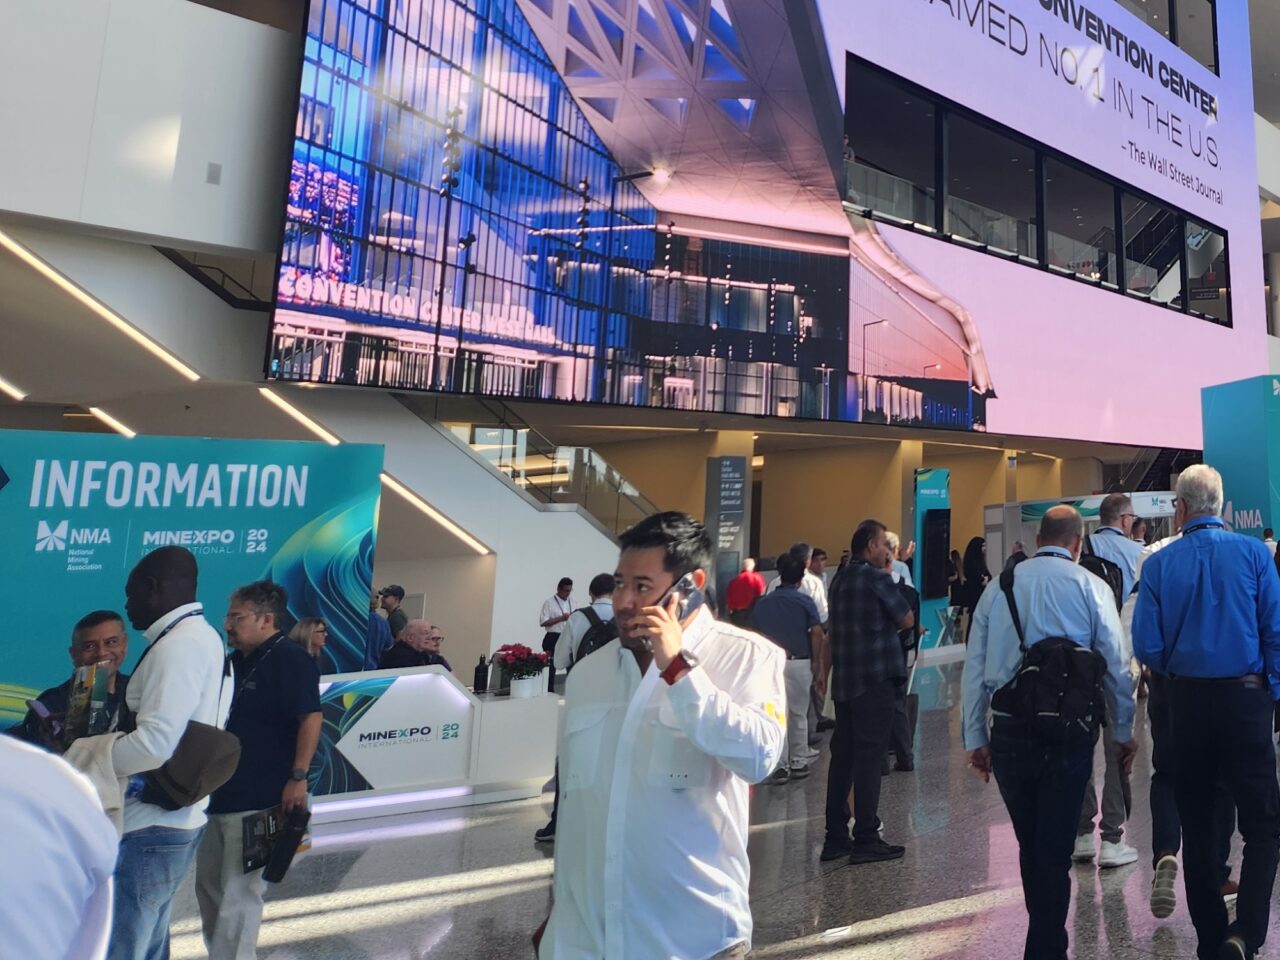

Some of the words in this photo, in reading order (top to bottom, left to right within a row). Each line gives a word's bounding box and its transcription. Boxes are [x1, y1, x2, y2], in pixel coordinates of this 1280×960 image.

[1159, 61, 1218, 122] CENTER
[1114, 77, 1134, 120] IN
[1141, 95, 1183, 148] THE
[1189, 124, 1222, 171] U.S.
[1149, 150, 1167, 177] Wall
[1169, 162, 1194, 191] Street
[1195, 177, 1224, 205] Journal
[278, 266, 418, 320] CONVENTION
[29, 459, 309, 508] INFORMATION
[1234, 508, 1264, 529] NMA
[70, 527, 112, 544] NMA
[143, 529, 235, 546] MINEXPO
[247, 528, 269, 540] 20
[68, 548, 95, 556] National
[245, 541, 268, 553] 24
[66, 563, 103, 572] Association
[67, 556, 89, 565] Mining
[359, 726, 432, 742] MINEXPO
[441, 722, 460, 731] 20
[358, 737, 433, 749] INTERNATIONAL
[441, 731, 460, 740] 24
